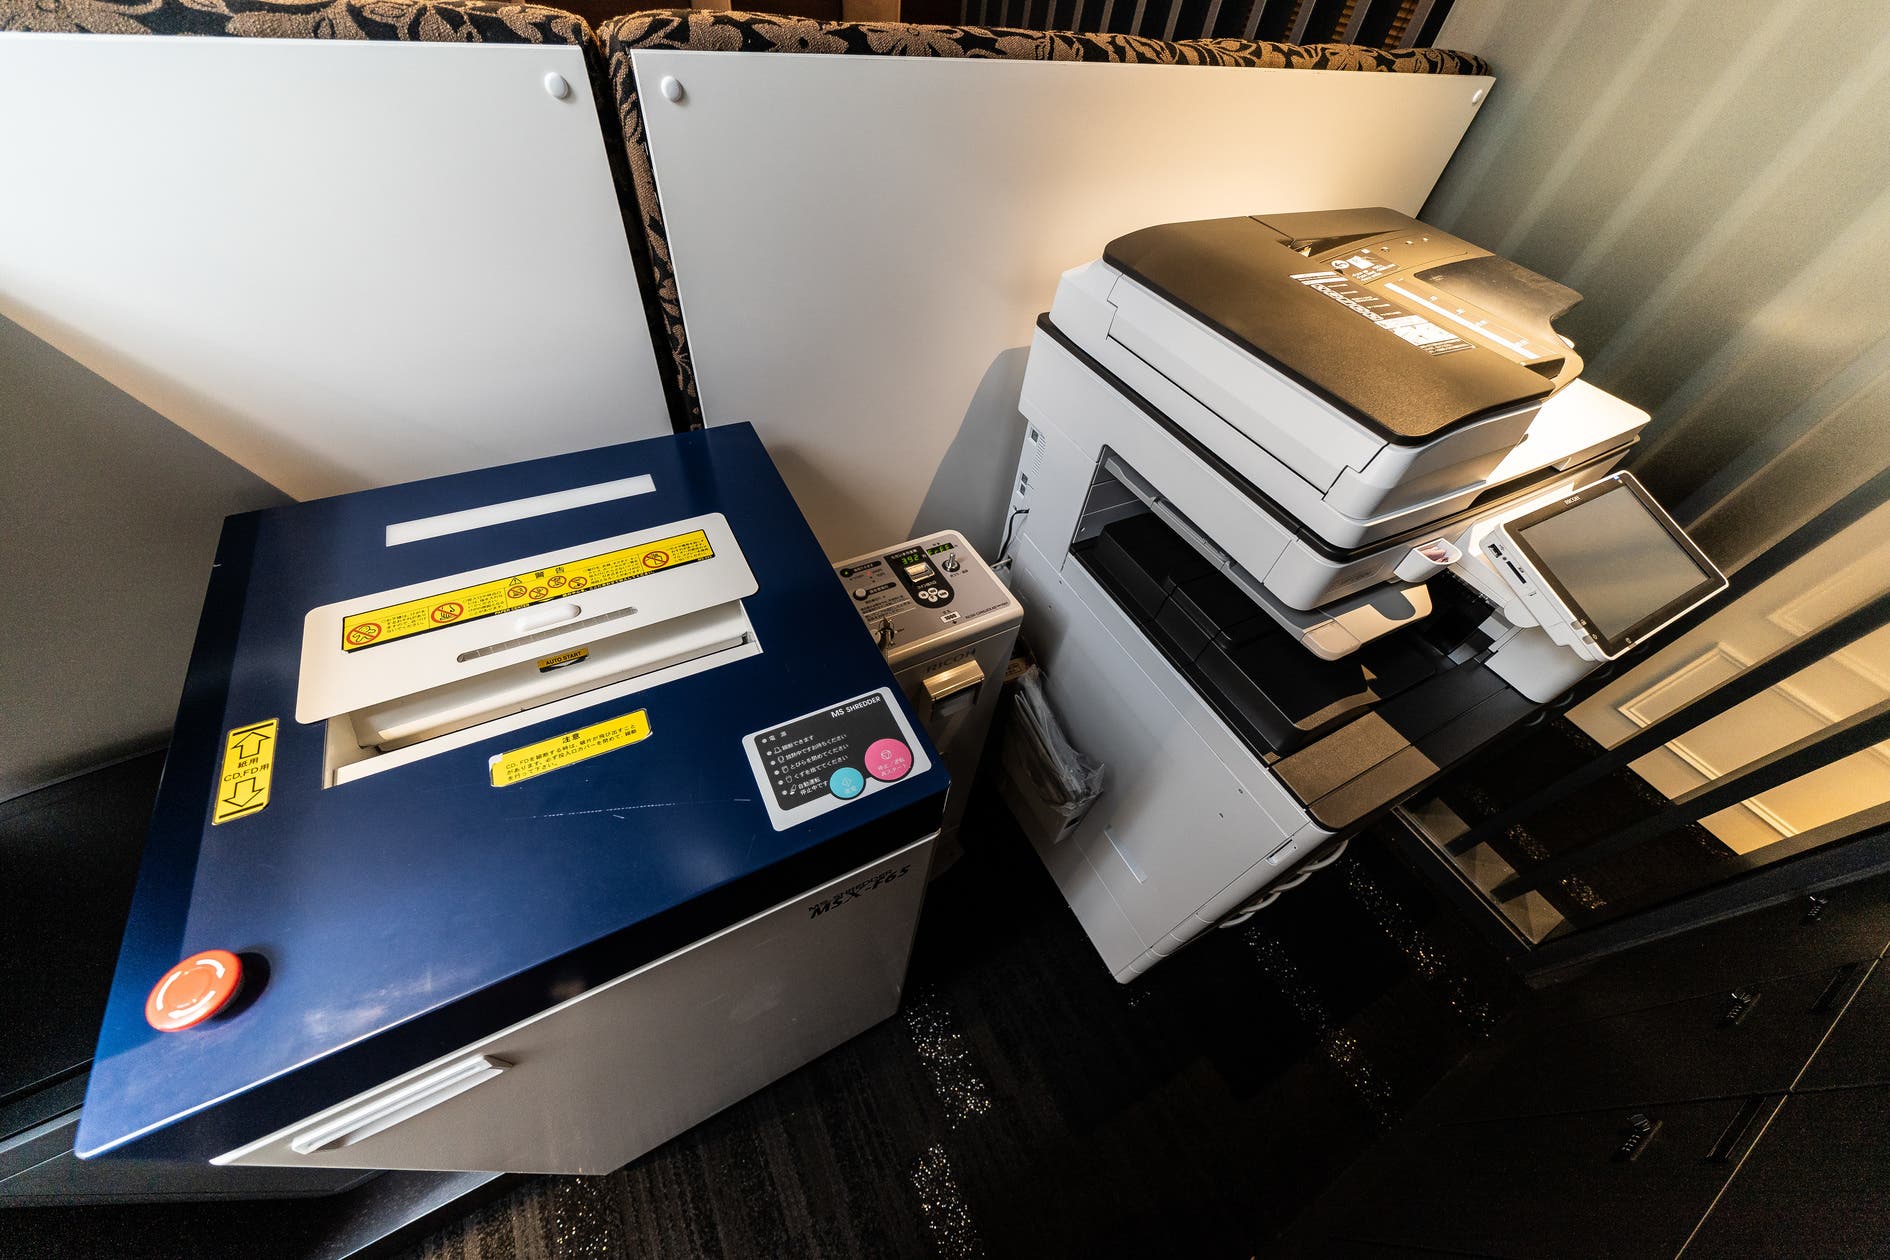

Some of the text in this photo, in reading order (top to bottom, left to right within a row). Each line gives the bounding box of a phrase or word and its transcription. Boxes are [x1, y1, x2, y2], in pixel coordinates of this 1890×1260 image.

[1563, 495, 1581, 505] RICOH
[545, 651, 581, 666] AUTO START
[926, 647, 976, 674] RICOH
[830, 695, 881, 718] MS SHREDDER
[561, 732, 581, 744] 注意
[237, 757, 258, 768] 紙用
[800, 780, 829, 796] 停止中です
